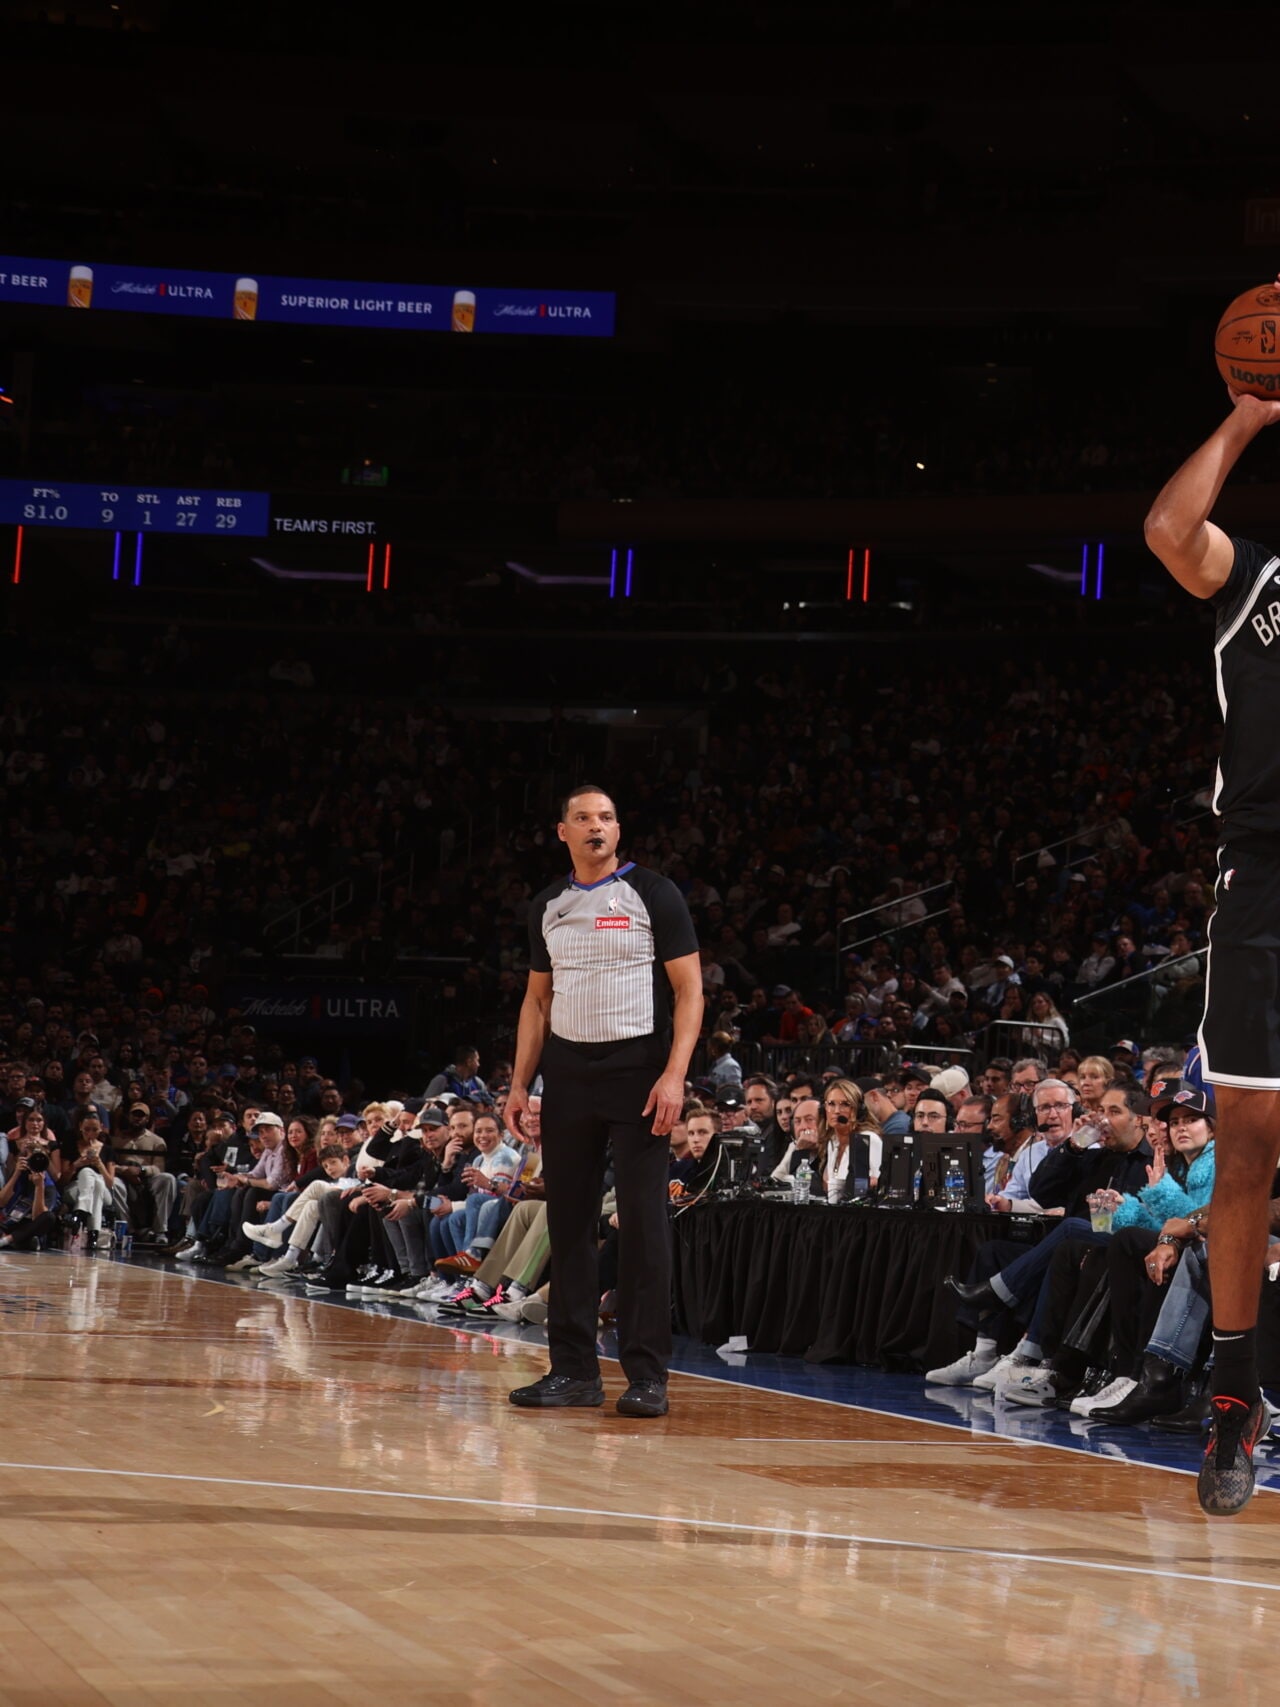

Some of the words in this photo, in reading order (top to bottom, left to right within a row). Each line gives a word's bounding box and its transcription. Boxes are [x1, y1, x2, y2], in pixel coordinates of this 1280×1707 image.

[11, 274, 48, 288] BEER
[168, 286, 213, 299] ULTRA
[280, 294, 350, 310] SUPERIOR
[353, 298, 393, 313] LIGHT
[397, 301, 433, 315] BEER
[547, 306, 592, 319] ULTRA
[32, 488, 61, 499] FT%
[101, 491, 119, 502] TO
[136, 493, 161, 505] STL
[176, 495, 201, 507] AST
[216, 497, 242, 509] REB
[23, 503, 68, 520] 81.0
[101, 508, 114, 523] 9
[142, 511, 153, 525] 1
[175, 512, 198, 527] 27
[215, 513, 237, 528] 29
[273, 518, 328, 533] TEAM'S
[331, 520, 377, 535] FIRST.
[596, 919, 629, 928] Emirates
[241, 996, 307, 1017] Michelob
[327, 998, 400, 1018] ULTRA
